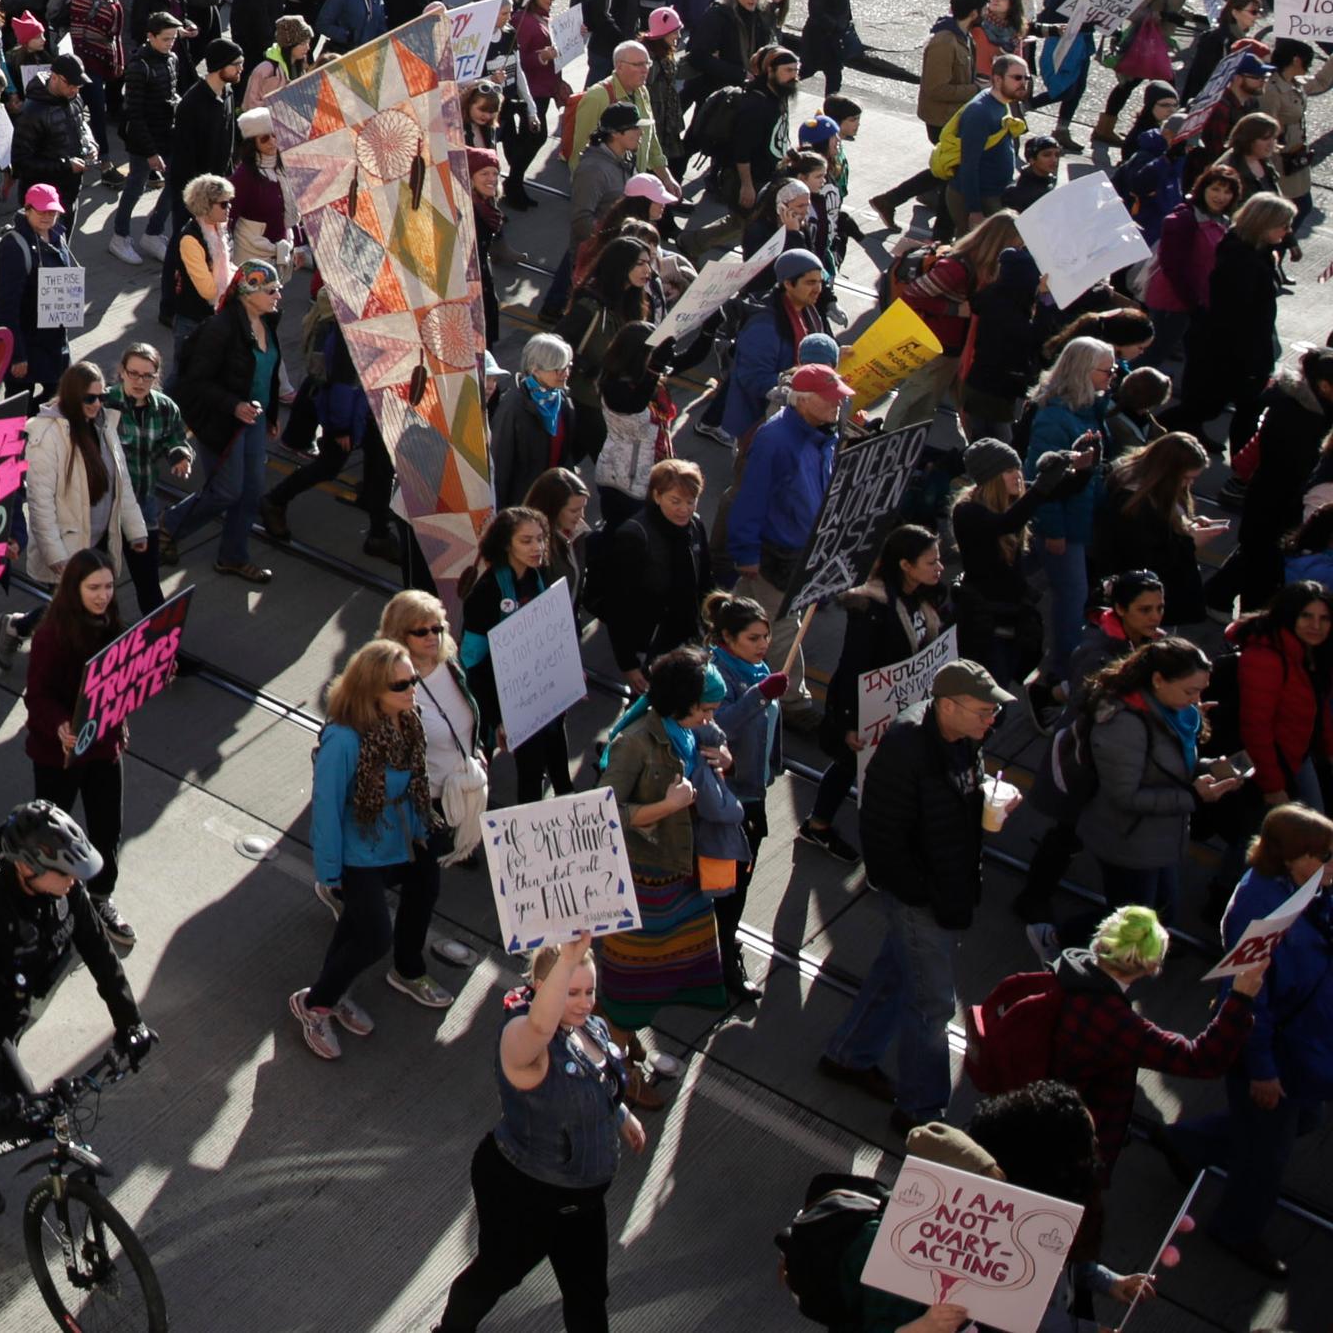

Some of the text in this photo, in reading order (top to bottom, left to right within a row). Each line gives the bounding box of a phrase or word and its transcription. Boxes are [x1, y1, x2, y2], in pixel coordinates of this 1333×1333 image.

[41, 287, 51, 296] OF
[45, 273, 80, 286] THE RISE
[48, 310, 79, 323] NATION
[818, 471, 910, 530] WOMEN
[806, 512, 878, 569] RISE
[491, 593, 562, 651] Revolution
[86, 619, 150, 694] LOVE
[86, 627, 181, 718] TRUMPS
[498, 637, 543, 676] is a
[864, 632, 949, 693] INJUSTICE
[98, 658, 175, 741] HATE!
[502, 671, 530, 701] time
[502, 802, 606, 859] if you stand
[507, 825, 614, 879] for NOTHING
[513, 857, 600, 891] then what will
[514, 900, 538, 923] you
[541, 882, 580, 919] FALL
[935, 1203, 999, 1234] NOT
[953, 1187, 1015, 1223] I AM
[909, 1239, 1010, 1282] ACTING
[920, 1222, 1014, 1259] OVARY-
